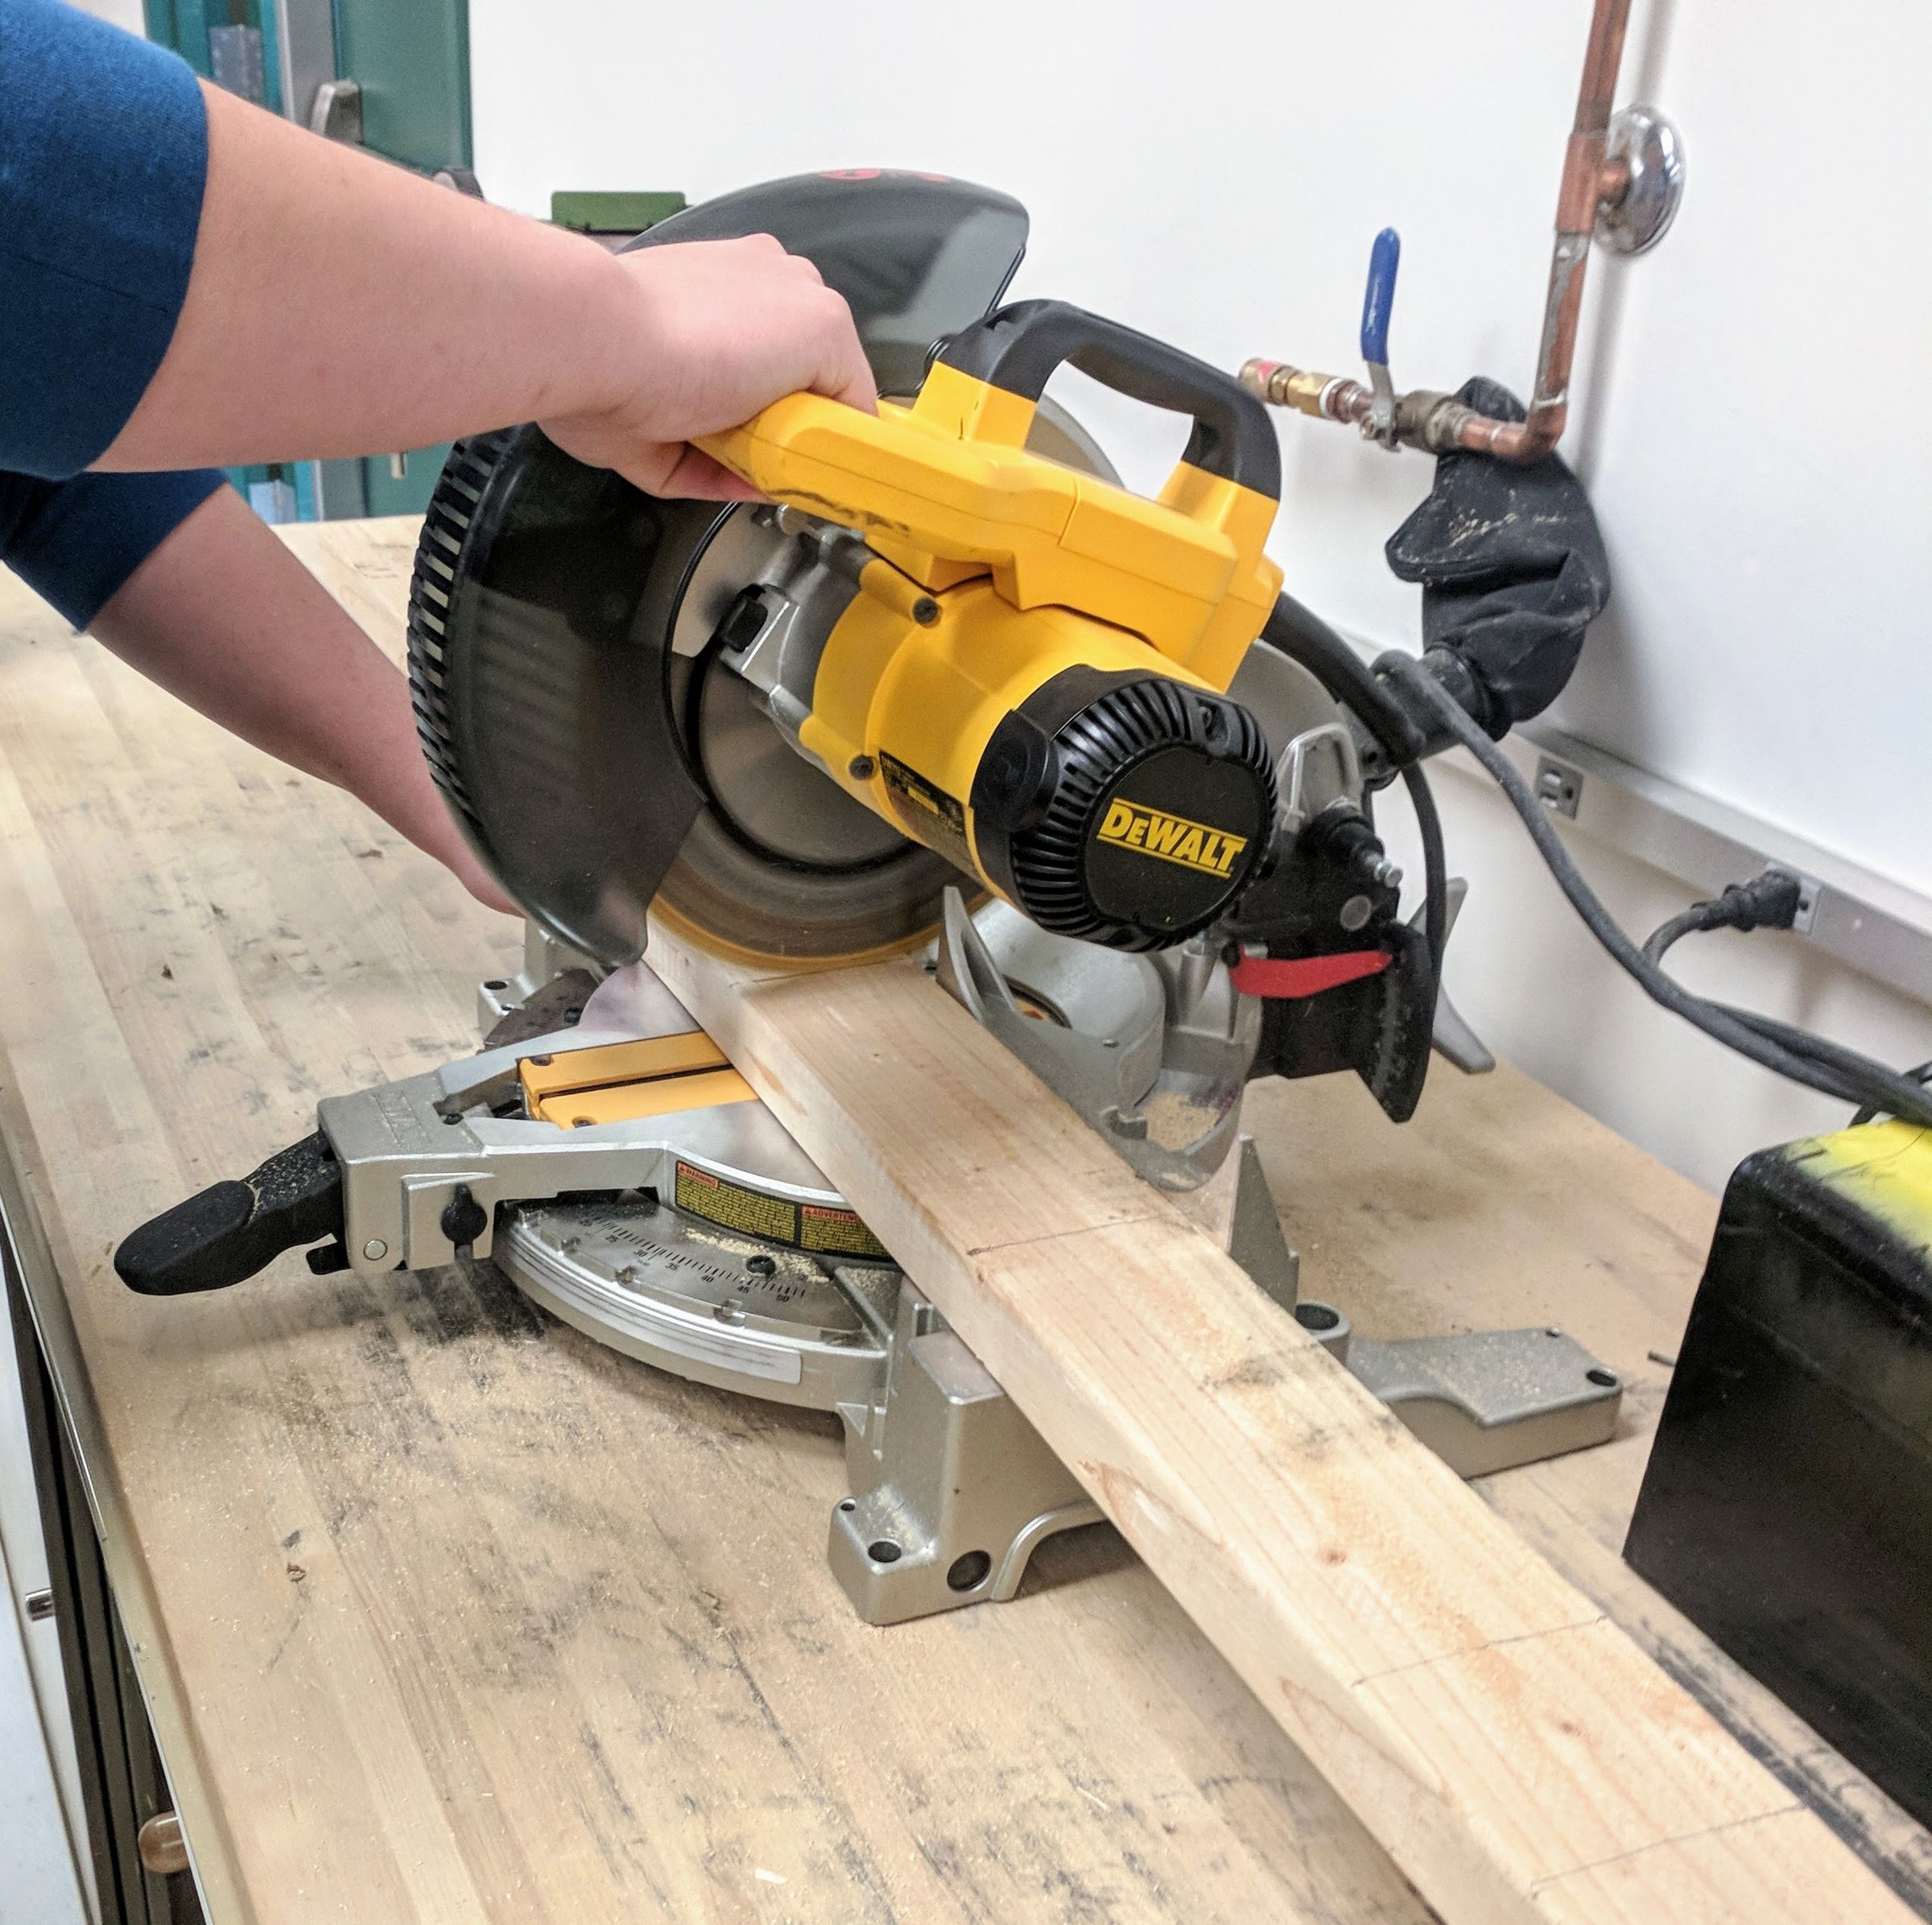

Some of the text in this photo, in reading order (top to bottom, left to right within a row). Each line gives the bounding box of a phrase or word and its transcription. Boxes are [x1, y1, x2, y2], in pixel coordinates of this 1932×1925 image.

[634, 1249, 648, 1258] 30
[665, 1262, 679, 1271] 35
[701, 1274, 715, 1283] 40
